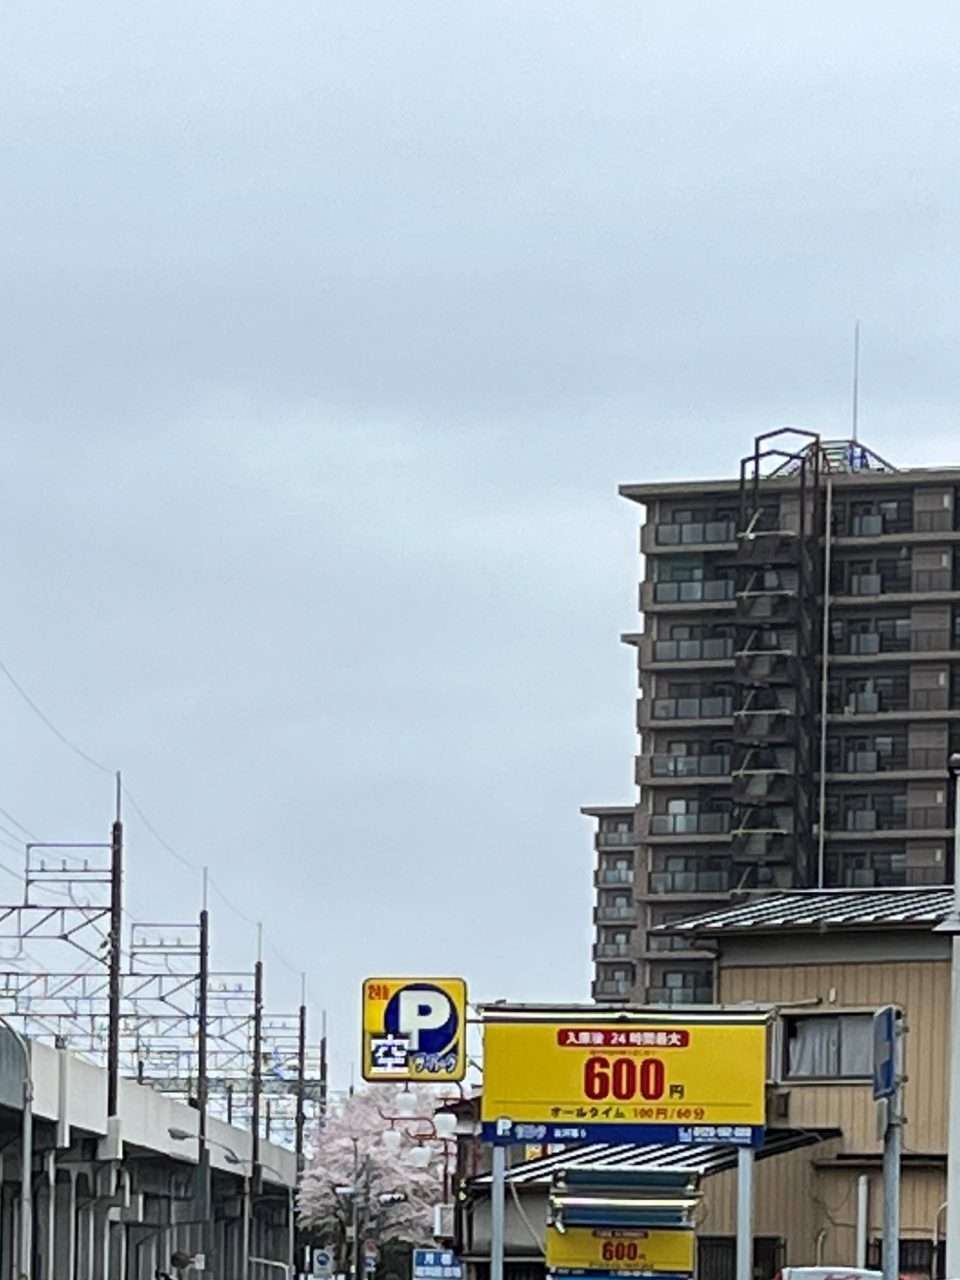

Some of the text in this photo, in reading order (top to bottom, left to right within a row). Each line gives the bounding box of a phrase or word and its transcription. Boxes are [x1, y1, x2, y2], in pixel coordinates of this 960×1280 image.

[399, 989, 451, 1051] P
[584, 1056, 685, 1101] 600 円
[602, 1241, 639, 1262] 600
